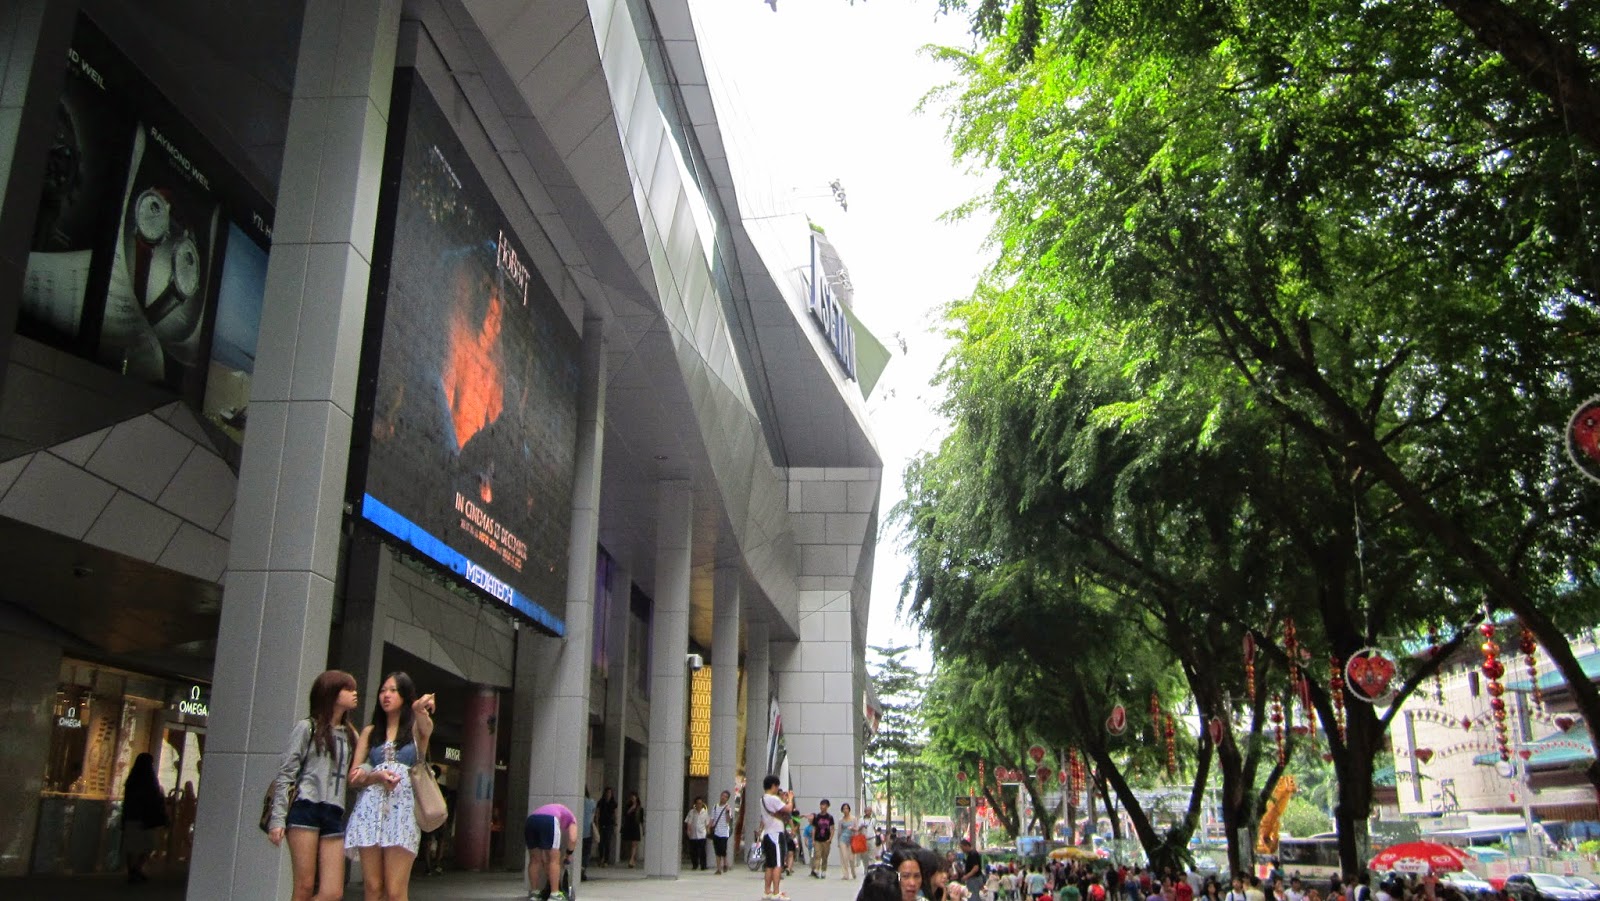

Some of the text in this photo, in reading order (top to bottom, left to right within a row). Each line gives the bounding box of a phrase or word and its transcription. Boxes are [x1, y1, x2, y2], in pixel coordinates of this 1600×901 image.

[82, 59, 106, 90] WEIL
[151, 126, 190, 170] RAYMOND
[192, 166, 210, 191] WEIL
[455, 491, 465, 513] IN
[465, 500, 495, 536] CINEMAS
[58, 716, 82, 728] OMEGA
[179, 700, 208, 717] OMEGA
